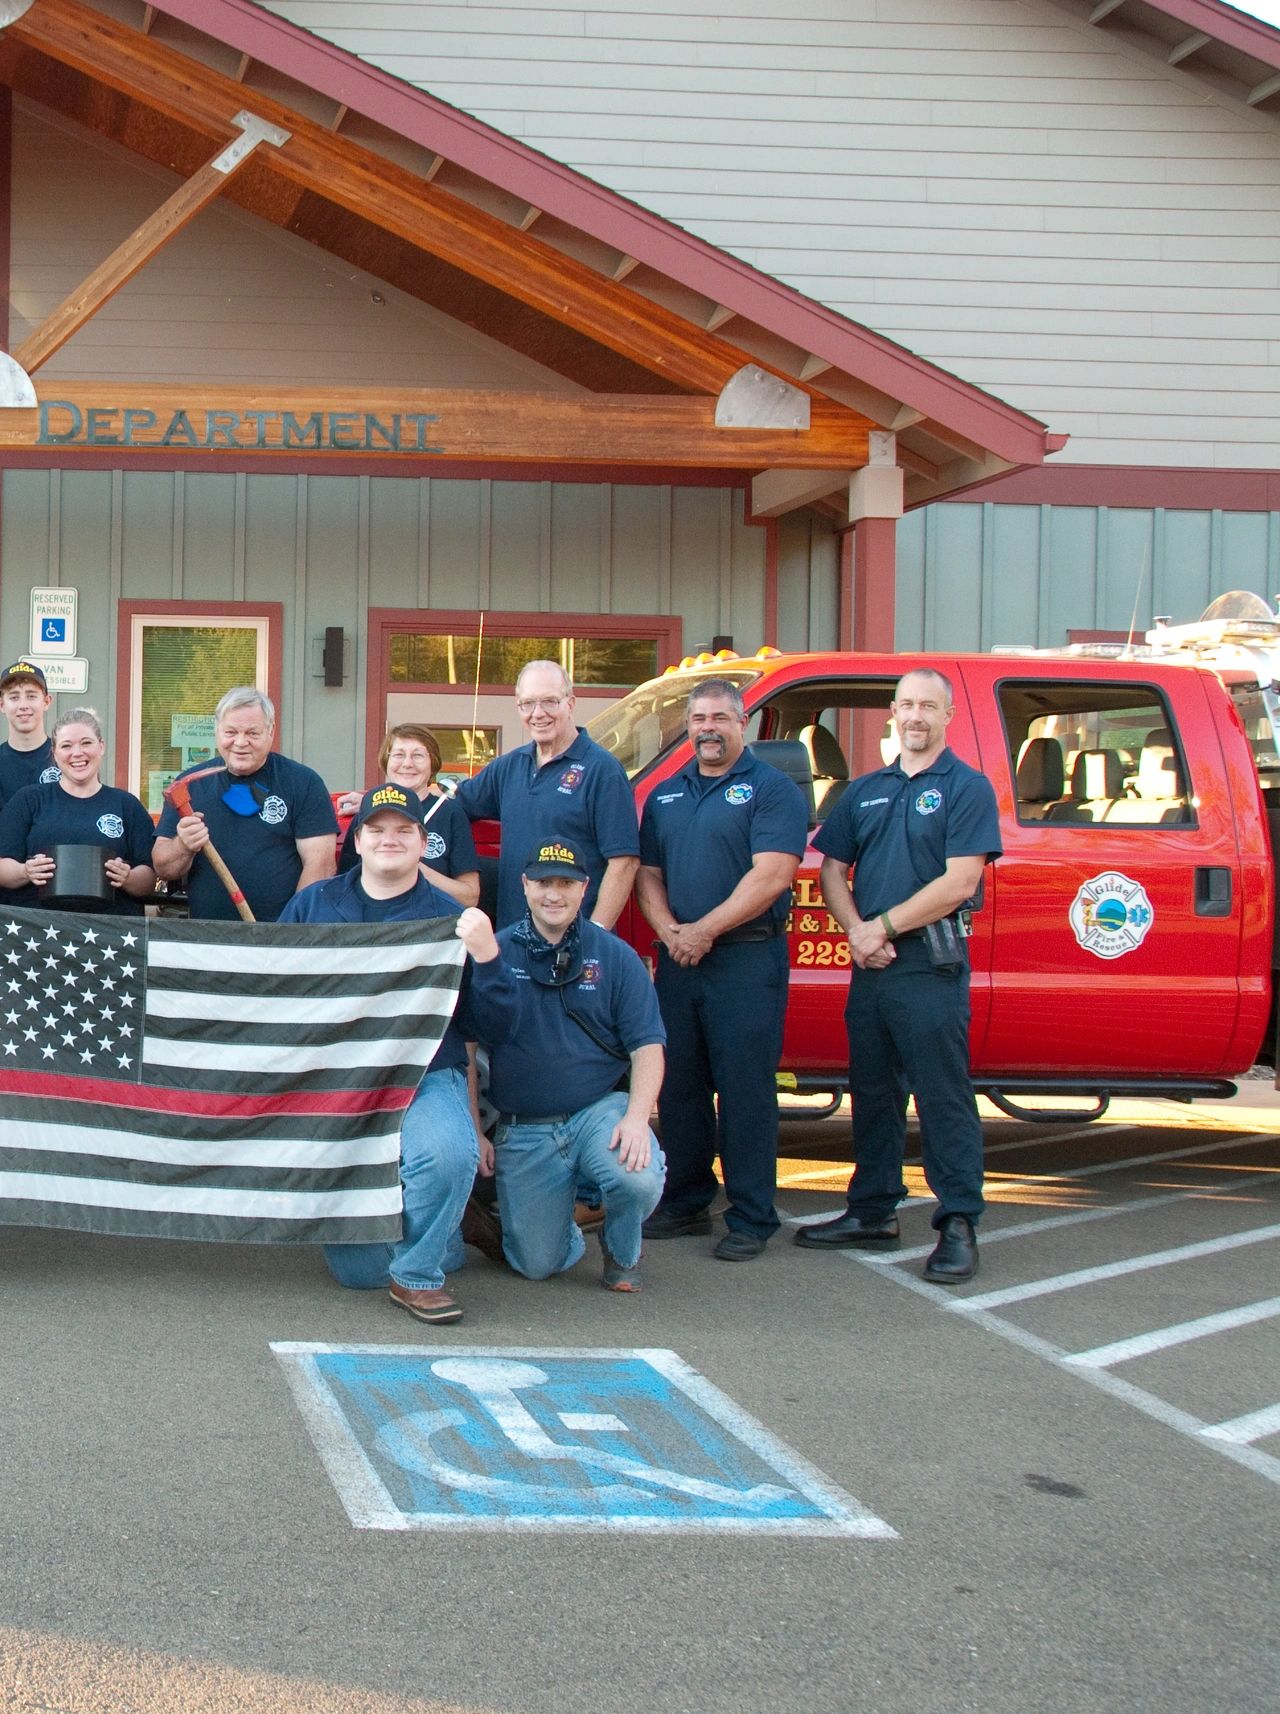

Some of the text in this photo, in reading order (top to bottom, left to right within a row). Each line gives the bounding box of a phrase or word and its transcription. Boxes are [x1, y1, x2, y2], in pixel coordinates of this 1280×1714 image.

[36, 400, 444, 452] DEPARTMENT
[35, 594, 74, 604] RESERVED
[37, 606, 71, 615] PARKING
[44, 665, 64, 674] VAN
[373, 788, 406, 802] Glide
[540, 846, 574, 859] Glide
[1095, 882, 1129, 897] Glide
[1095, 932, 1116, 943] Fire
[1092, 940, 1127, 951] Rescue
